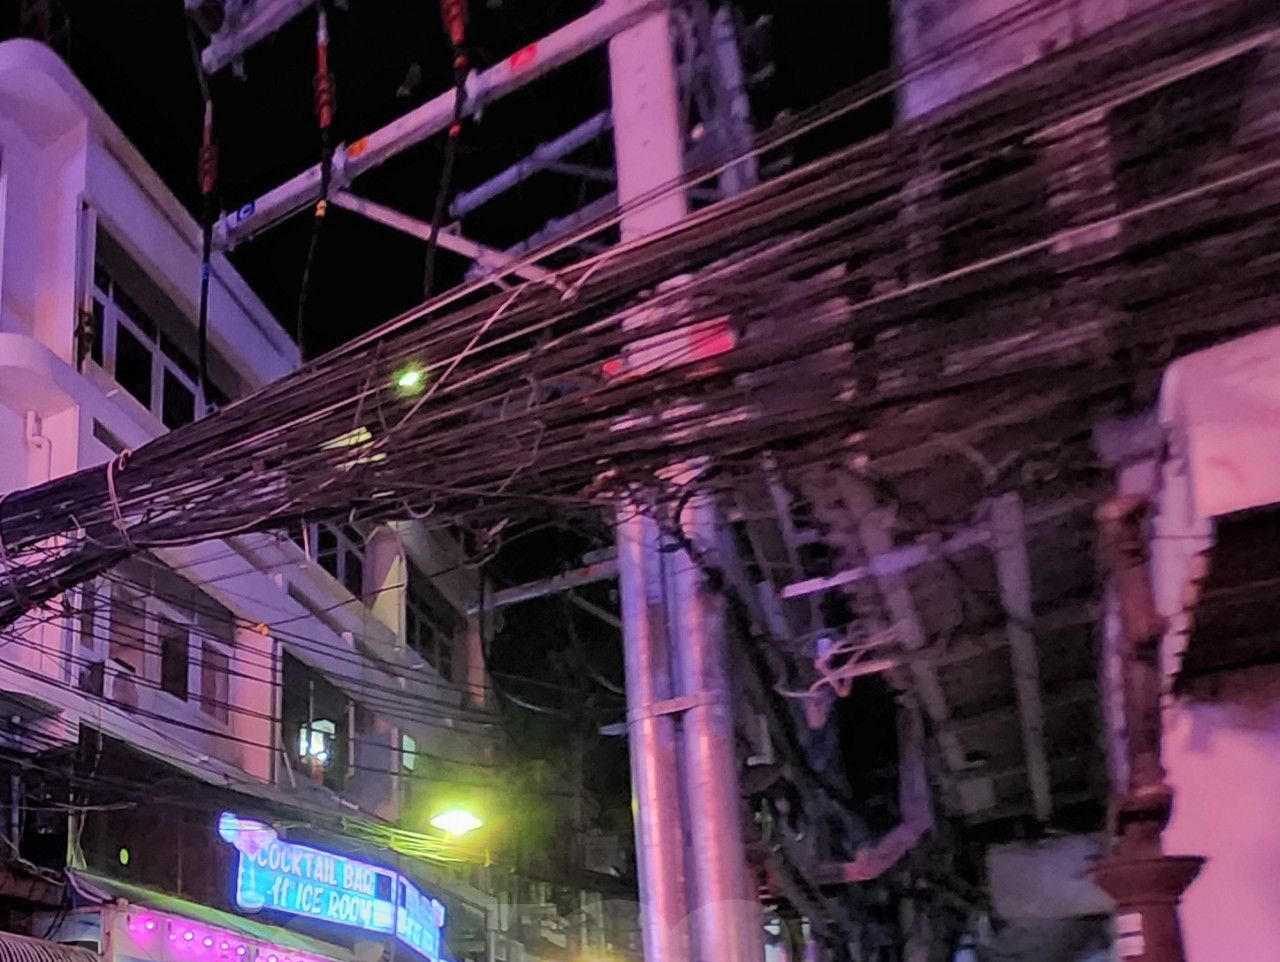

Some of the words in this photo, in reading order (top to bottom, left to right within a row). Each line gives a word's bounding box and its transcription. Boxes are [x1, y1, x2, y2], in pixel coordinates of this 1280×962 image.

[258, 842, 338, 887] COCKTAIL
[343, 863, 375, 894] BAR
[296, 883, 324, 913] ICE
